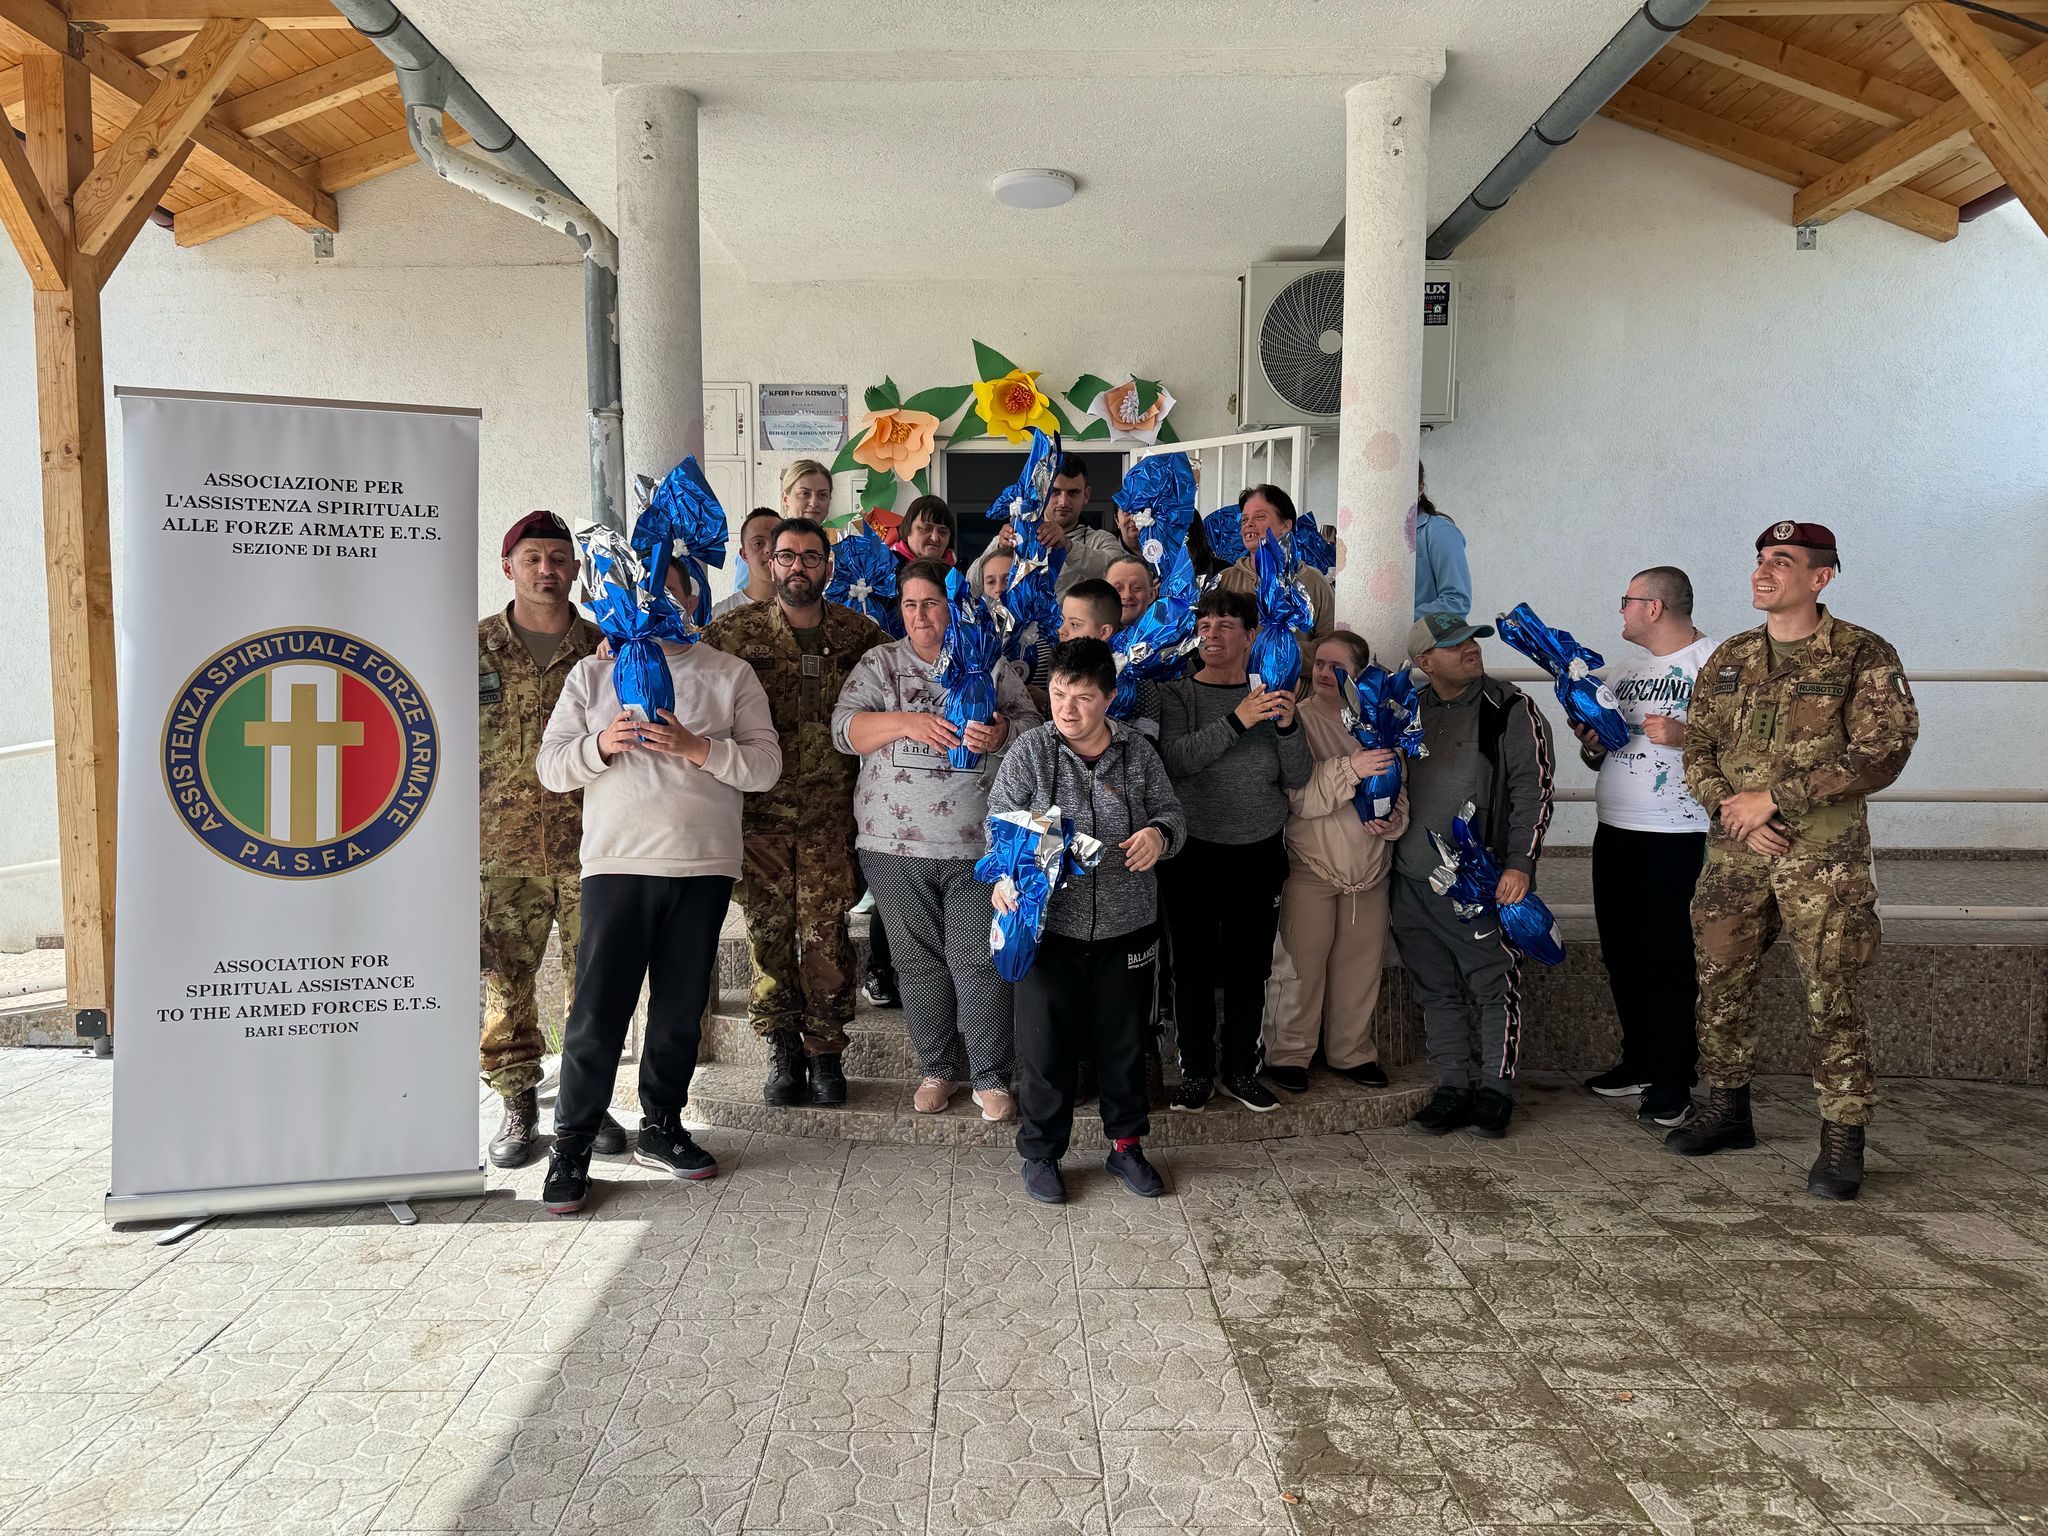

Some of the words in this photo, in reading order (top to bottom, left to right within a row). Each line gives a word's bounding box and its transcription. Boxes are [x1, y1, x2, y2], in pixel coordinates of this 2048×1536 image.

[1424, 283, 1447, 294] UX
[203, 472, 358, 493] ASSOCIAZIONE
[364, 480, 404, 495] PER
[165, 493, 313, 513] L'ASSISTENZA
[317, 500, 439, 518] SPIRITUALE
[161, 517, 219, 533] ALLE
[225, 520, 294, 536] FORZE
[298, 522, 385, 539] ARMATE
[390, 526, 442, 541] E.T.S.
[232, 542, 308, 556] SEZIONE
[312, 544, 331, 557] DI
[335, 545, 377, 558] BARI
[207, 634, 361, 686] SPIRITUALE
[361, 653, 426, 725] FORZE
[1799, 685, 1843, 695] RUSSOTTO
[170, 685, 223, 833] ASSISTENZA
[902, 743, 930, 754] and
[386, 730, 431, 827] ARMATE
[213, 956, 345, 974] ASSOCIATION
[350, 954, 390, 969] FOR
[186, 981, 293, 998] SPIRITUAL
[297, 975, 415, 993] ASSISTANCE
[156, 1008, 184, 1023] TO
[189, 1006, 231, 1021] THE
[235, 1003, 306, 1019] ARMED
[312, 999, 388, 1015] FORCES
[393, 996, 441, 1011] E.T.S.
[245, 1025, 283, 1038] BARI
[288, 1021, 359, 1036] SECTION
